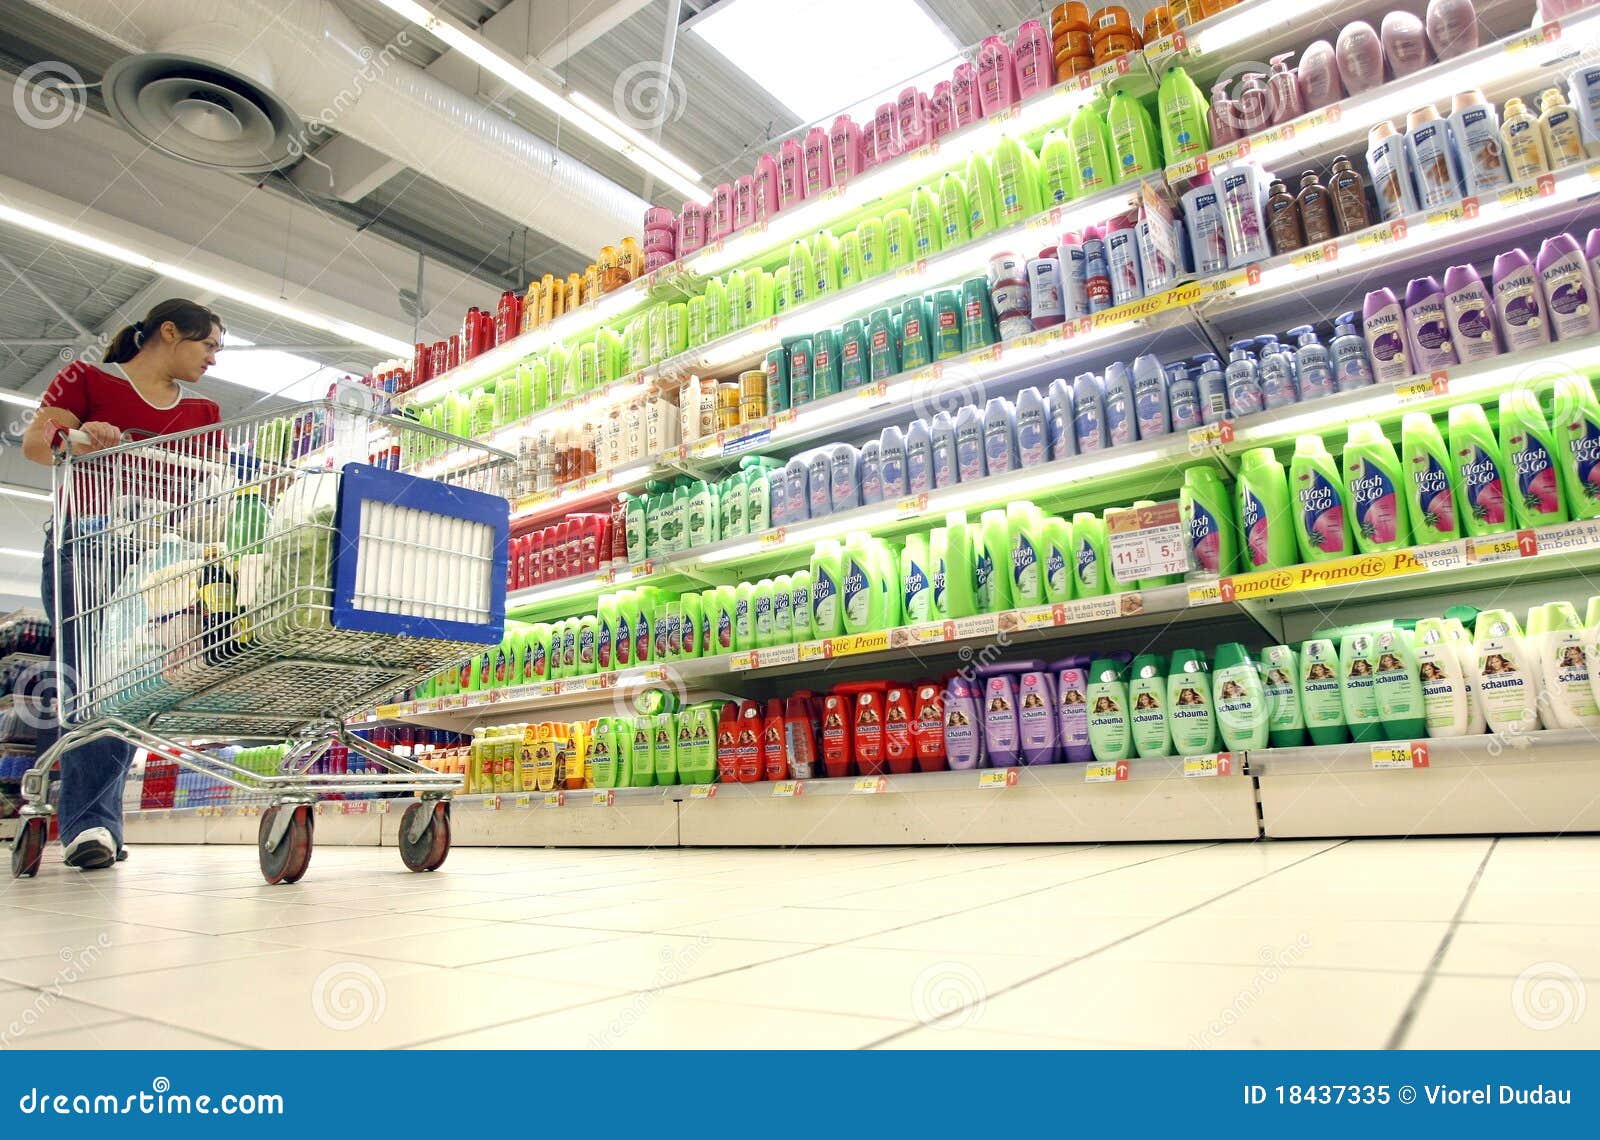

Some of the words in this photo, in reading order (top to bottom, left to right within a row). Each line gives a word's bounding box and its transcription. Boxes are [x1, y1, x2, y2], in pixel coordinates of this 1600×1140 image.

[1543, 263, 1582, 285] SUNSILK
[1498, 275, 1534, 293] SUNSILK
[1450, 290, 1485, 306] SUNSILK
[1366, 313, 1399, 329] SUNSILK
[1512, 447, 1546, 465] Wash
[1462, 460, 1494, 476] Wash
[1530, 460, 1548, 472] Go
[1414, 470, 1446, 484] Wash
[1478, 472, 1495, 484] Go
[1351, 475, 1383, 493] Wash
[1431, 480, 1447, 491] Go
[1300, 486, 1331, 502] Wash
[1367, 487, 1384, 500] Go
[1316, 497, 1332, 509] Go
[1143, 511, 1154, 525] 2
[1011, 547, 1033, 560] Wash
[1431, 556, 1461, 569] copil
[845, 574, 863, 587] Wash
[904, 573, 922, 585] Wash
[1375, 675, 1409, 687] schauma
[1481, 677, 1524, 692] schauma
[1304, 683, 1339, 693] schauma
[1218, 701, 1251, 713] schauma
[1133, 713, 1164, 725] schauma
[1173, 709, 1208, 719] schauma
[1091, 716, 1124, 729] schauma
[1391, 750, 1406, 763] 5,25
